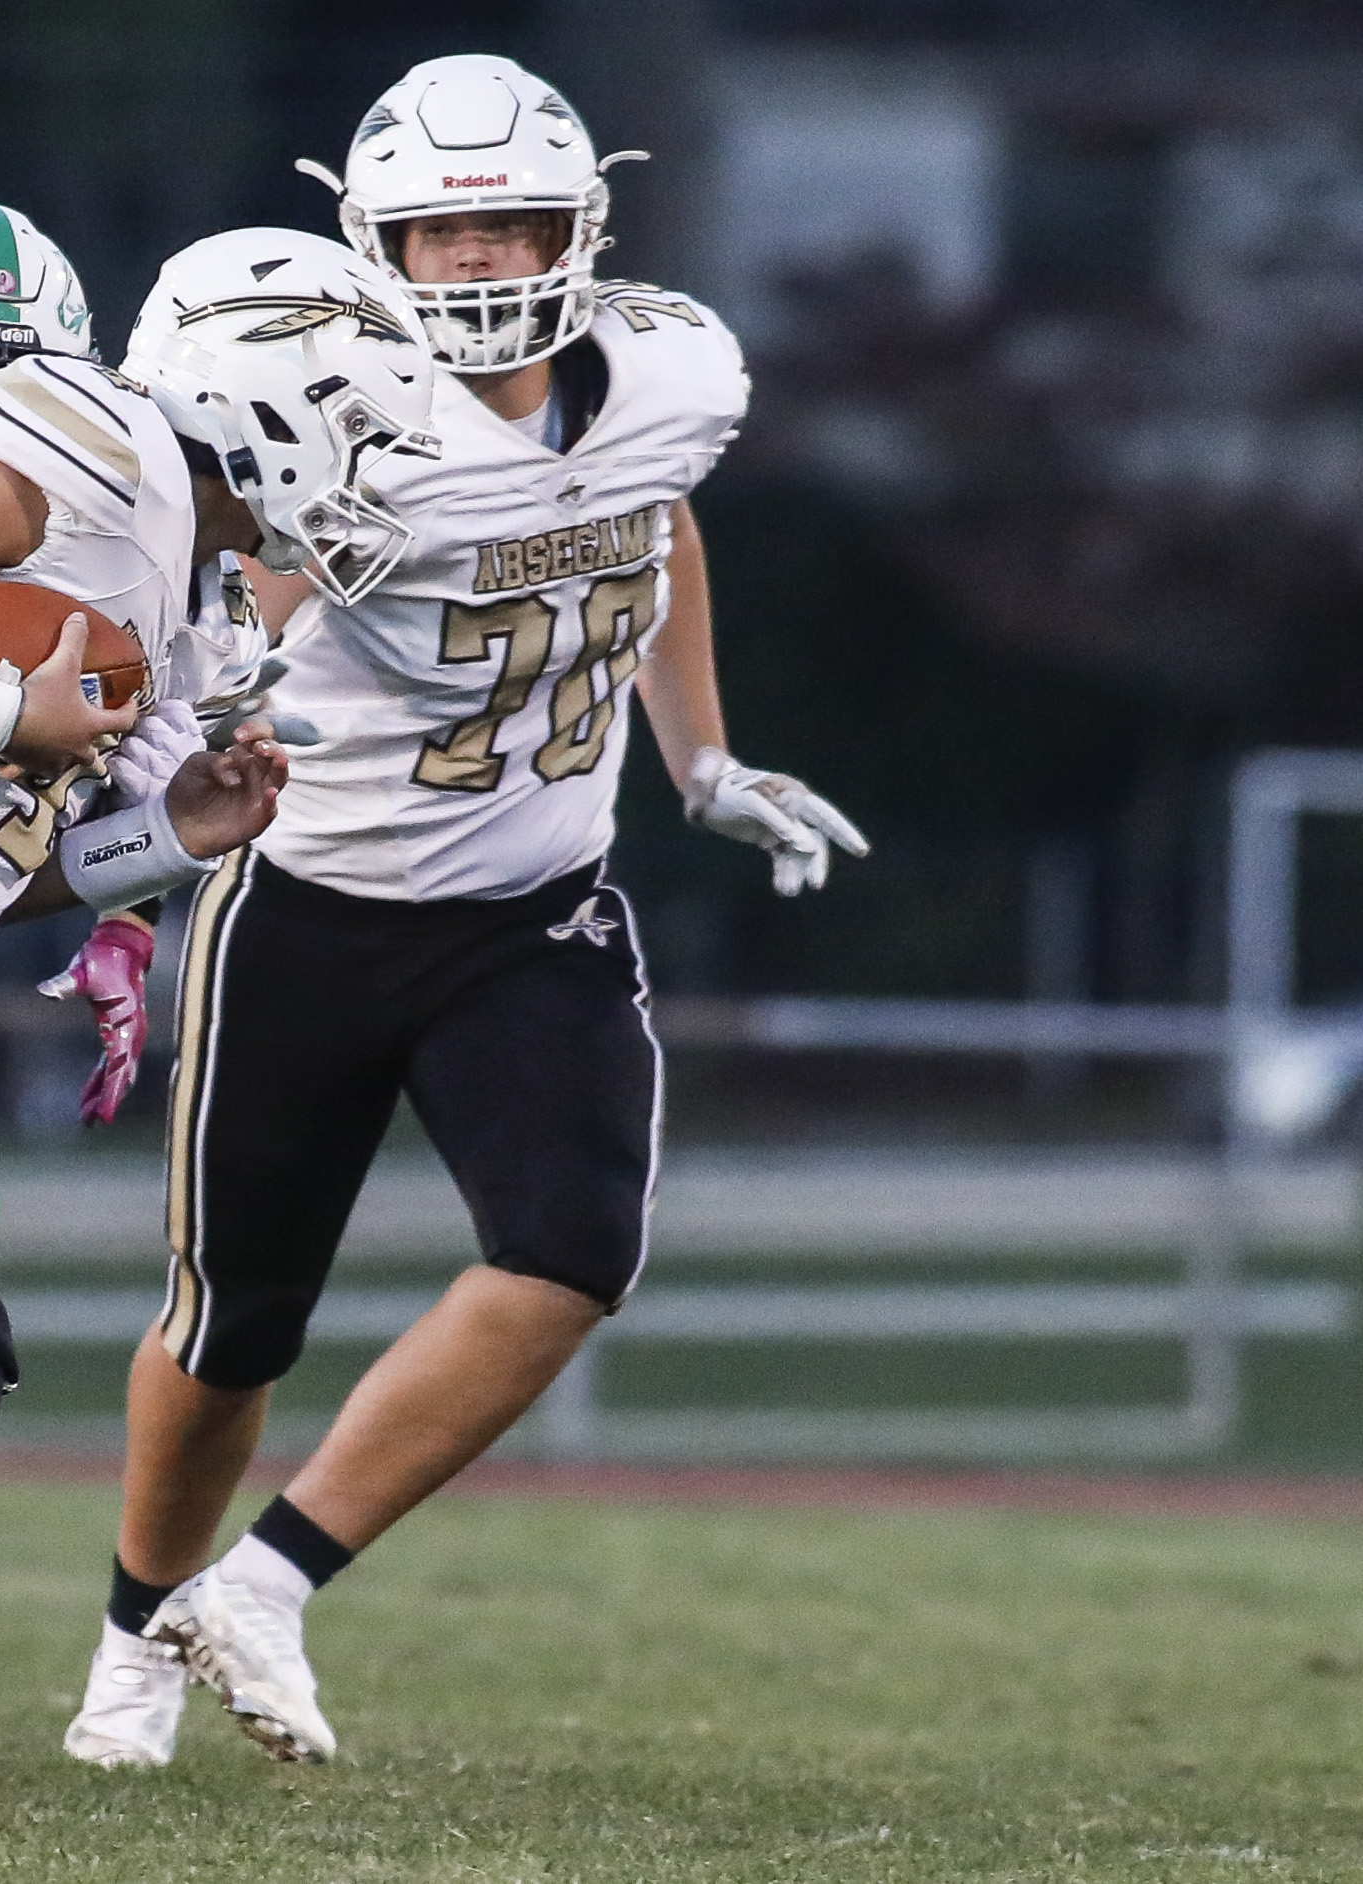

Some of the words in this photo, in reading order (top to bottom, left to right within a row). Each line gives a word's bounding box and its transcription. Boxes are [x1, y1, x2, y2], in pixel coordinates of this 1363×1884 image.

[443, 174, 507, 189] Riddell
[474, 506, 657, 594] ABSEGAM
[408, 568, 657, 792] 70
